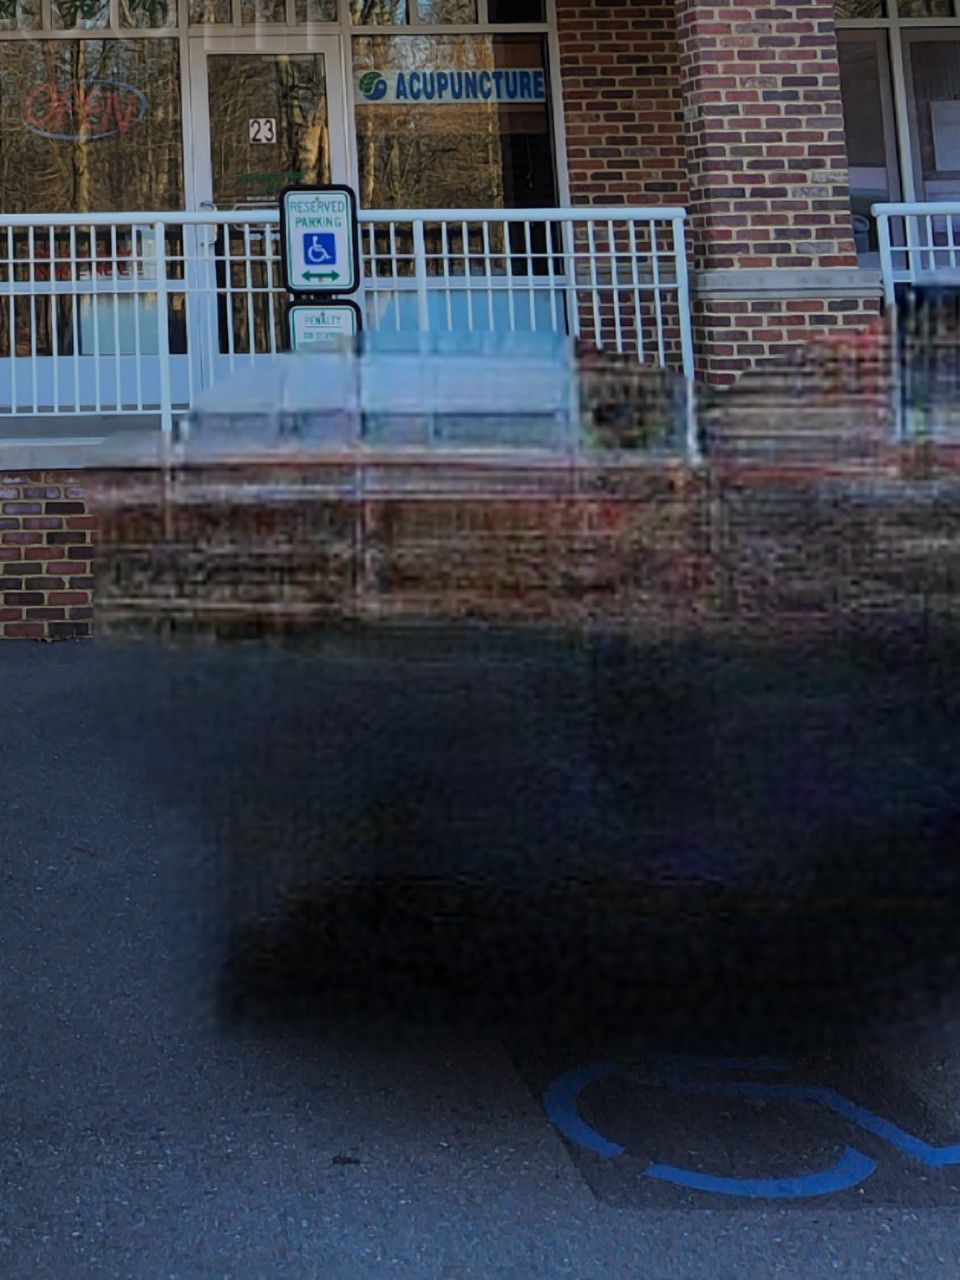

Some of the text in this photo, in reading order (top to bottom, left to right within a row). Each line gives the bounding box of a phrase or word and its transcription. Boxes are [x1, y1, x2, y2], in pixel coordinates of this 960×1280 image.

[395, 70, 545, 101] ACUPUNCTURE
[250, 120, 275, 142] 23
[290, 200, 345, 213] RESERVED
[295, 216, 342, 228] PARKING
[303, 315, 342, 325] PENALTY
